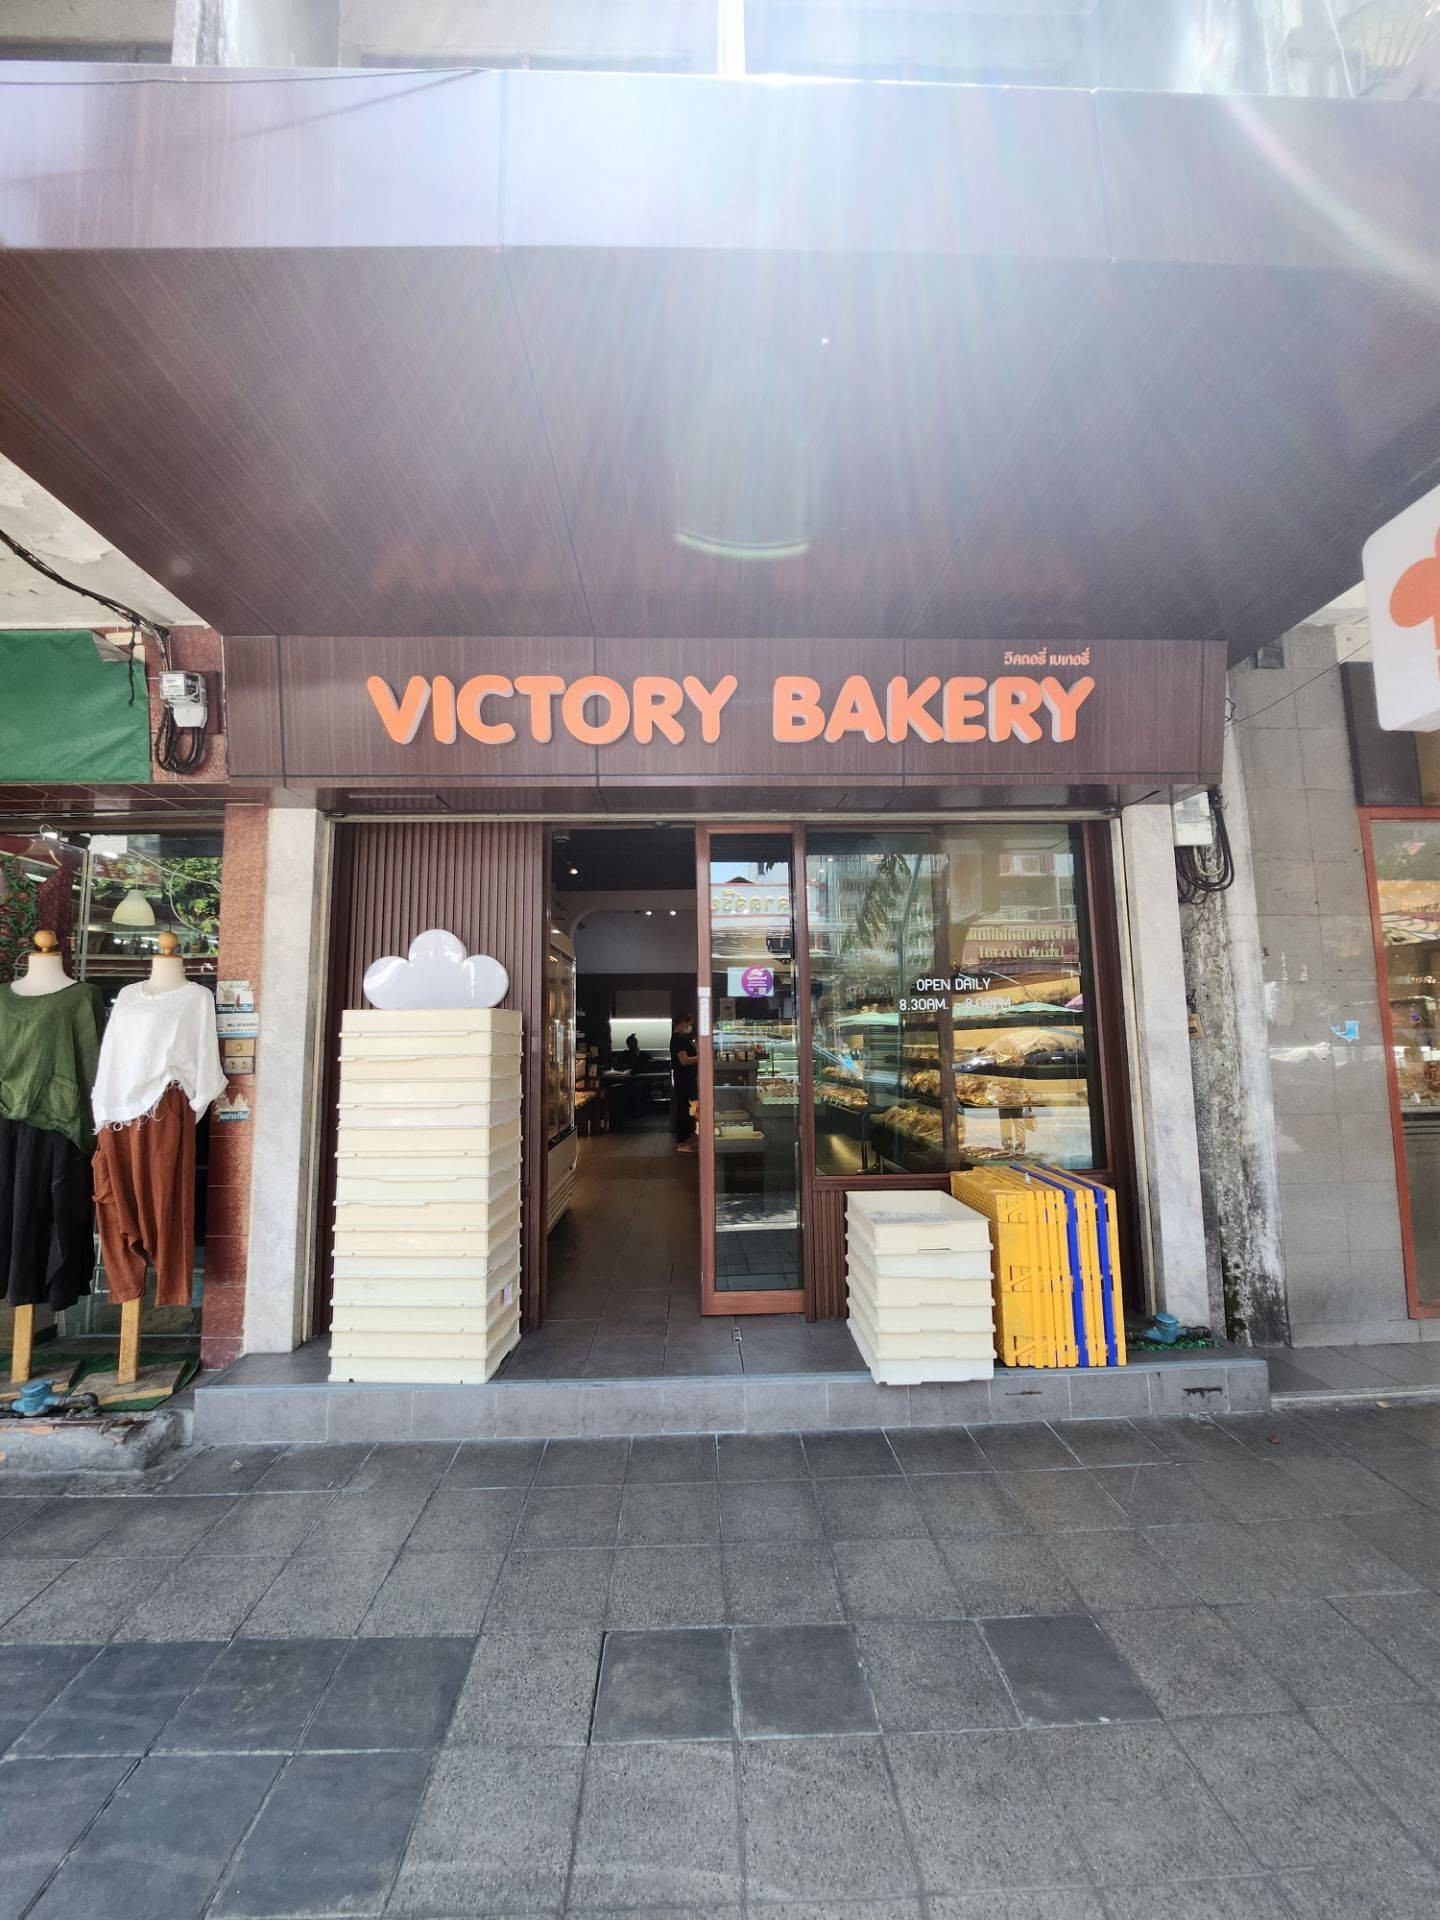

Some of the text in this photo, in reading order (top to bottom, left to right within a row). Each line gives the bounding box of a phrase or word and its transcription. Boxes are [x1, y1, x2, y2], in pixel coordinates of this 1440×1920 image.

[366, 673, 1096, 746] VICTORY BAKERY
[916, 977, 991, 992] OPEN DAILY
[899, 998, 949, 1012] 8.30AM.
